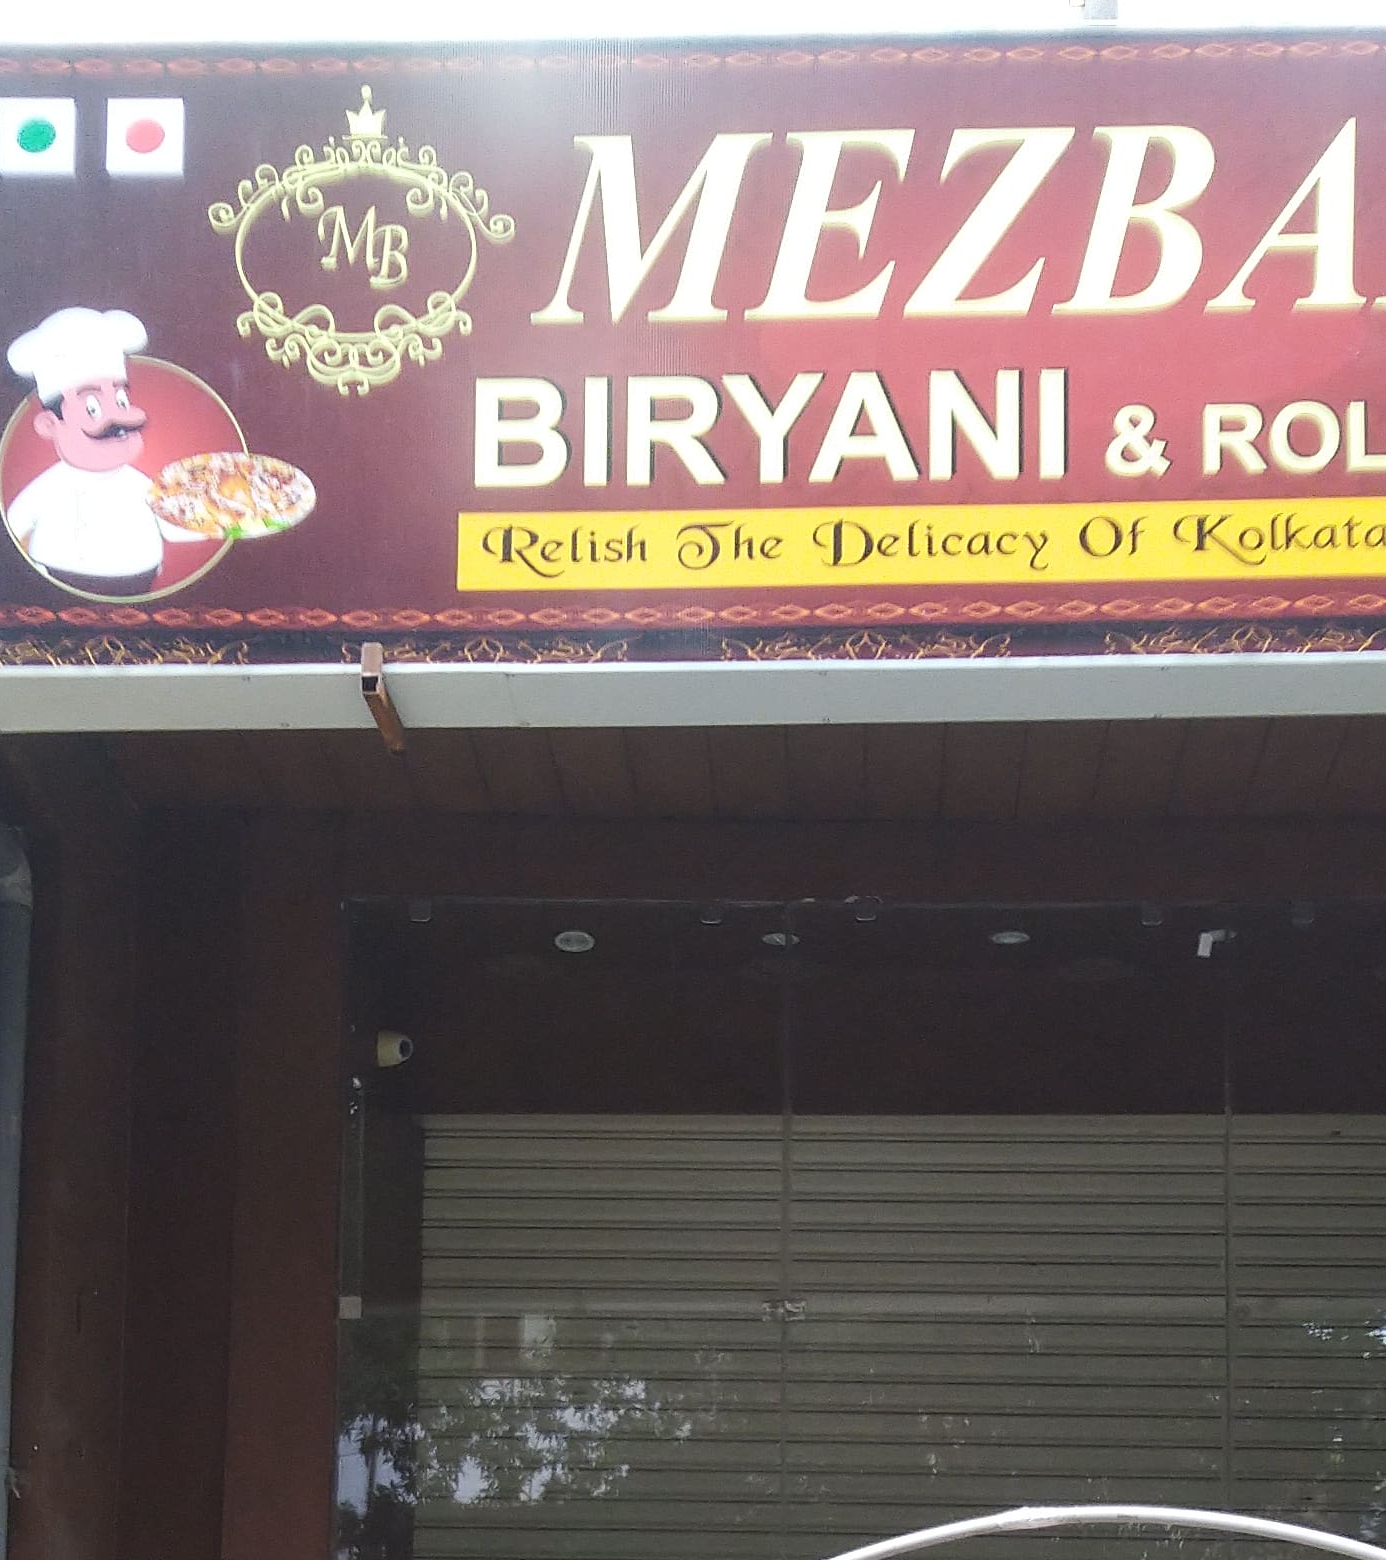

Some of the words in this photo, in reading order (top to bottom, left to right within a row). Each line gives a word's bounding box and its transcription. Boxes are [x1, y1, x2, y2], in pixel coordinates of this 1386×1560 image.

[473, 367, 1065, 488] BIRYANI
[1104, 403, 1171, 478] &
[482, 522, 649, 580] Relish
[676, 519, 784, 570] The
[812, 517, 1051, 572] Delicacy
[1078, 514, 1150, 558] Of
